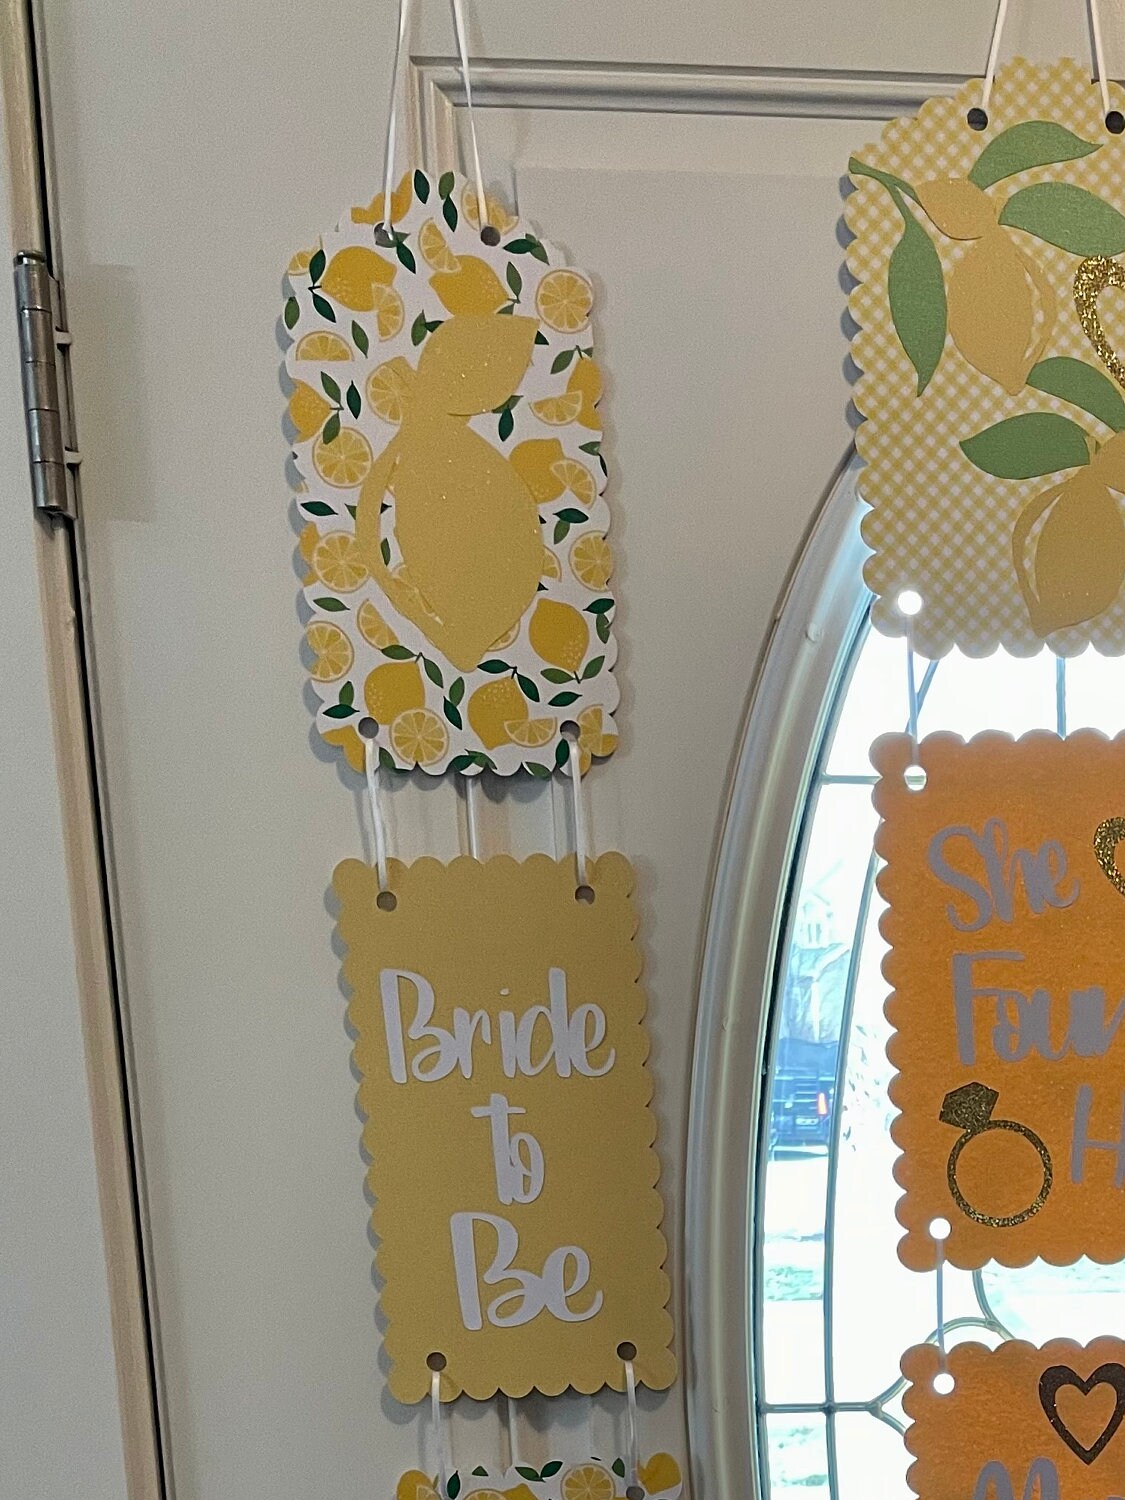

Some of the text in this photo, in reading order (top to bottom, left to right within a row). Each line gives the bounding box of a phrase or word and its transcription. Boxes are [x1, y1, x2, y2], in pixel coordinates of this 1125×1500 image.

[928, 817, 1080, 932] She
[380, 967, 616, 1084] Bride
[470, 1093, 545, 1205] to
[450, 1211, 604, 1331] Be
